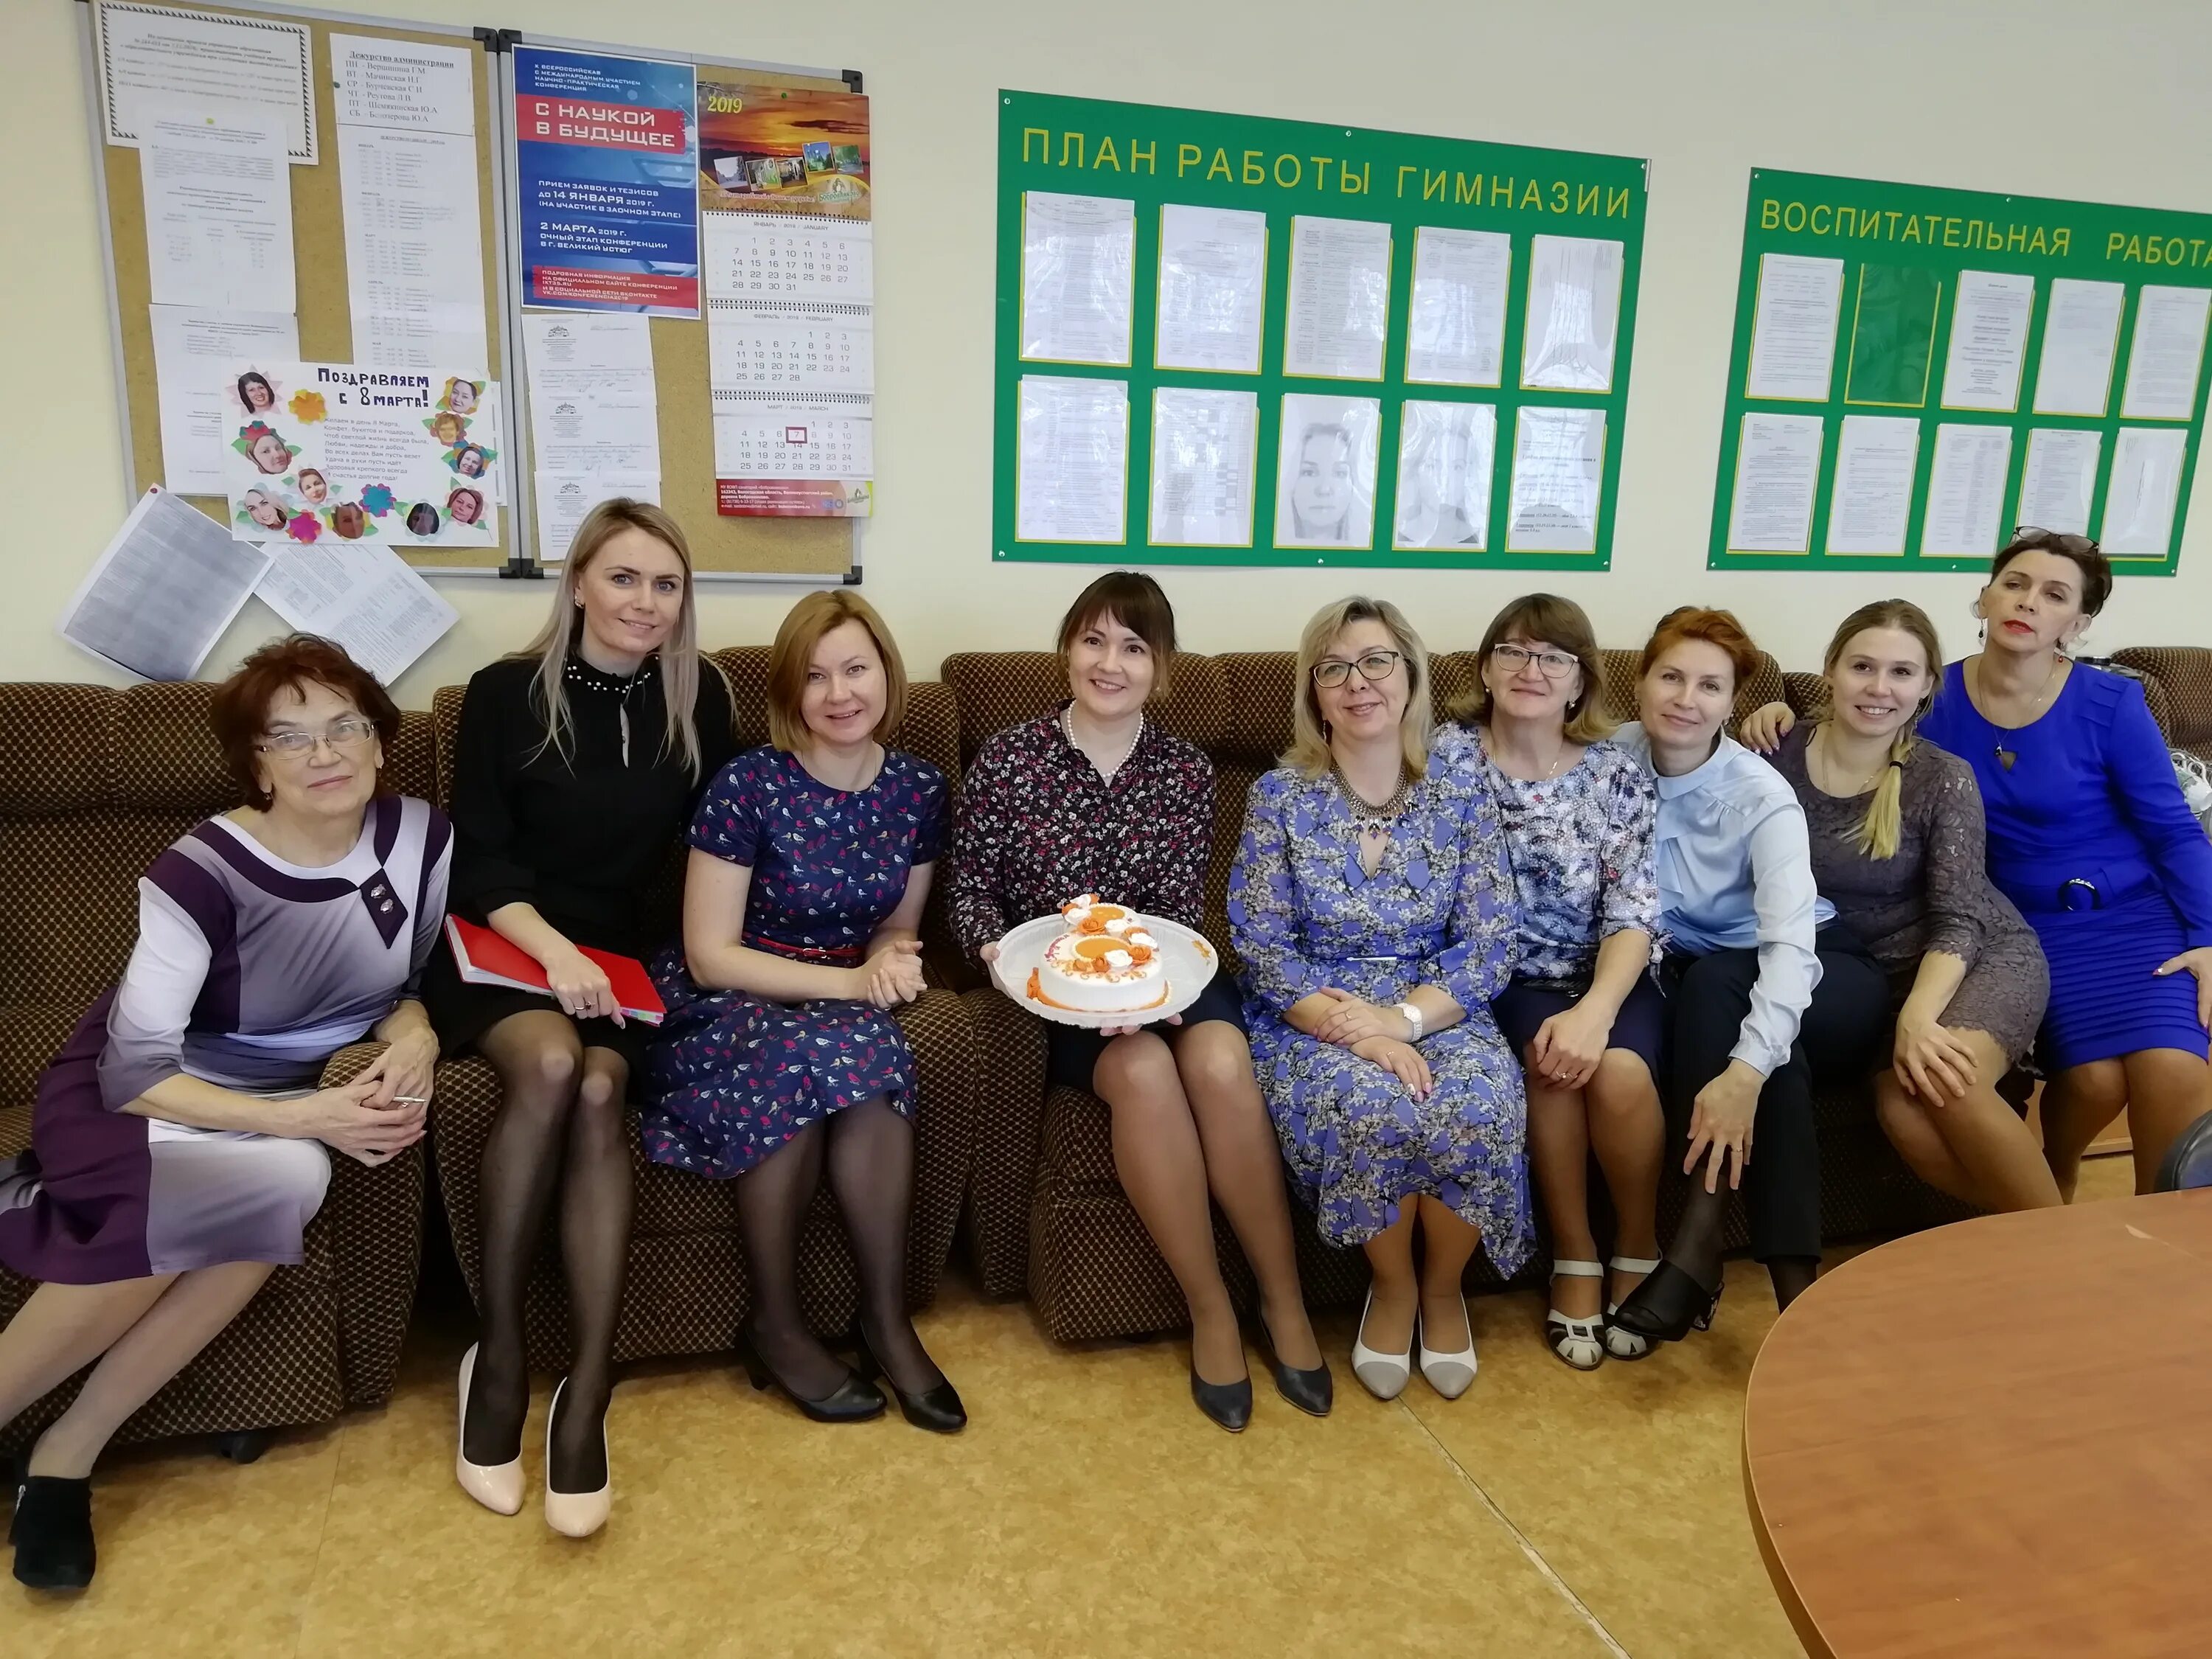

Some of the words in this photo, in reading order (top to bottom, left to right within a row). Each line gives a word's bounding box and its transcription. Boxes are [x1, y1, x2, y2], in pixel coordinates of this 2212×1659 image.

[349, 51, 392, 62] Дежурство
[394, 58, 454, 68] администрации
[541, 64, 601, 75] ВСЕРОССИЙСКАЯ
[541, 70, 604, 81] МЕЖДУНАРОДНЫМ
[535, 83, 587, 91] КОНФЕРЕНЦИЯ
[708, 96, 742, 113] 2019
[536, 103, 549, 116] С
[559, 105, 655, 126] НАУКОЙ
[536, 122, 550, 135] В
[559, 125, 675, 147] БУДУЩЕЕ
[1022, 127, 1156, 175] ПЛАН
[1178, 144, 1370, 195] РАБОТЫ
[1397, 165, 1630, 219] ГИМНАЗИИ
[539, 181, 570, 189] ПРИЕМ
[572, 184, 607, 192] ЗАЯВОК
[618, 187, 658, 197] ТЕЗИСОВ
[553, 191, 566, 199] 14
[569, 192, 623, 204] ЯНВАРЯ
[556, 203, 597, 211] УЧАСТИЕ
[607, 206, 649, 216] ЗАОЧНОМ
[552, 223, 596, 234] МАРТА
[1761, 199, 2070, 257] ВОСПИТАТЕЛЬНАЯ
[540, 233, 574, 242] ОЧНЫЙ
[600, 237, 667, 248] КОНФЕРЕНЦИИ
[558, 243, 600, 251] ВЕЛИКИЙ
[585, 273, 630, 281] ИНФОРМАЦИЯ
[627, 282, 678, 291] КОНФЕРЕНЦИИ
[339, 392, 347, 405] С
[361, 387, 370, 406] 8
[374, 389, 428, 407] МАРТА!
